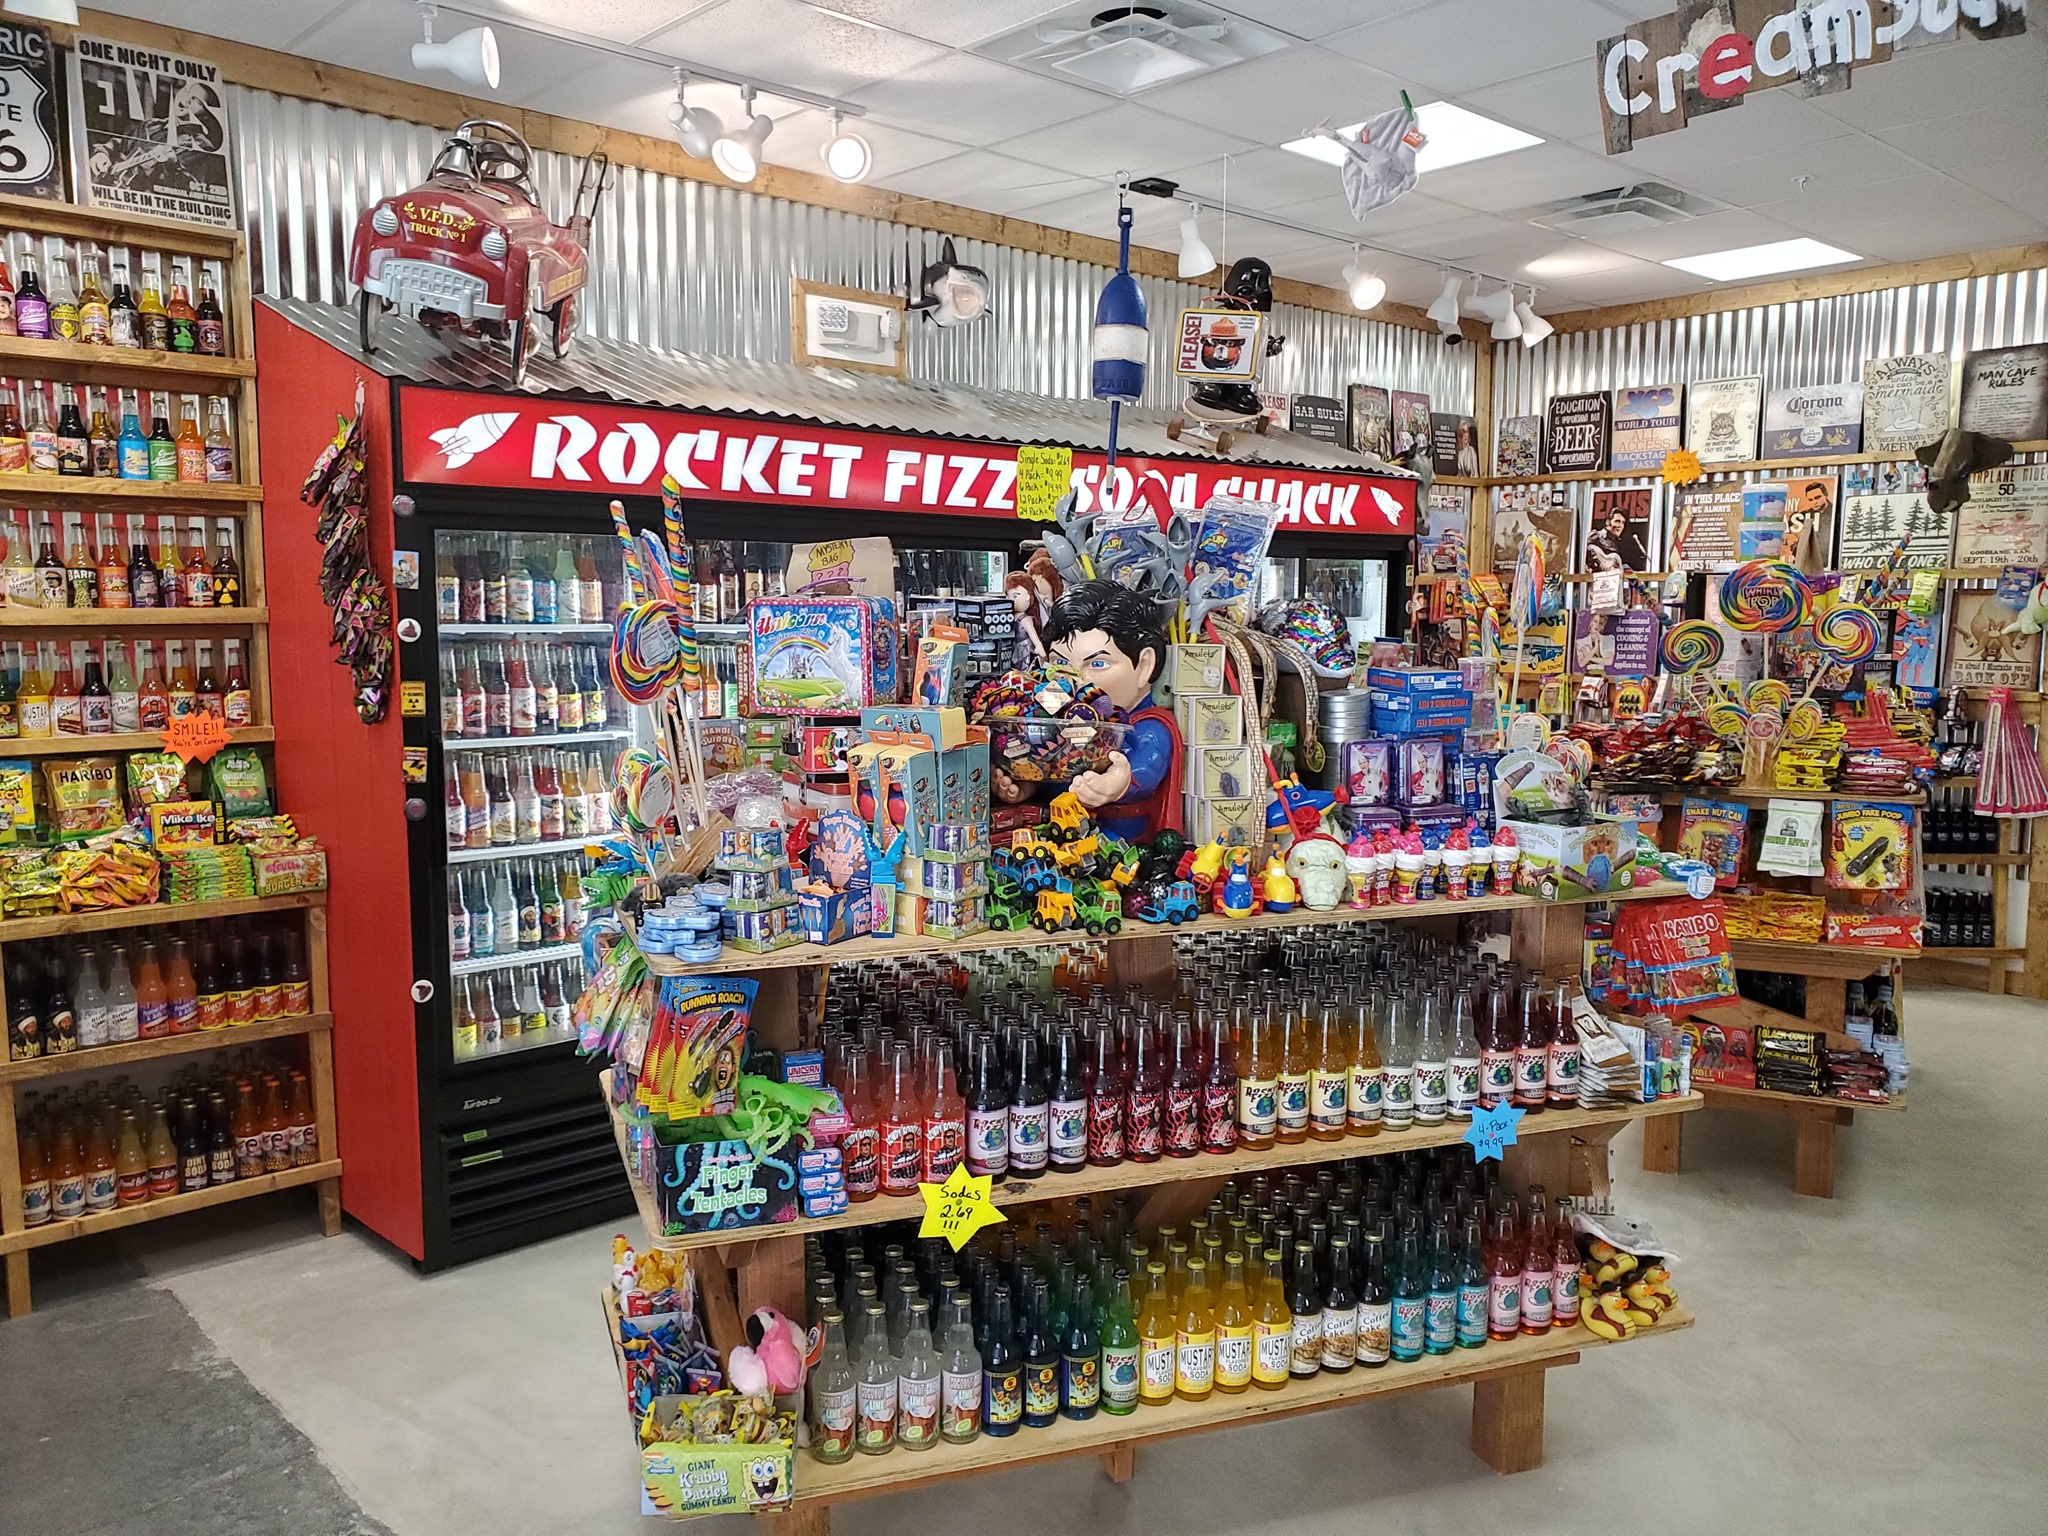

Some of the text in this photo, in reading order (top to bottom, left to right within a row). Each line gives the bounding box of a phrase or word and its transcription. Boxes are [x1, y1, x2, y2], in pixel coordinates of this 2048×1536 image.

[79, 39, 217, 82] ONE NIGHT ONLY
[91, 186, 122, 204] WILL
[123, 190, 139, 206] BE
[141, 193, 153, 208] IN
[155, 195, 177, 211] THE
[178, 199, 232, 220] BUILDING
[420, 207, 458, 227] V.F.D.
[410, 222, 444, 238] TRUCK
[1181, 316, 1203, 370] PLEASE!
[1876, 356, 1936, 380] ALWAYS
[1977, 366, 2038, 382] MAN CAVE
[1988, 377, 2025, 389] RULES
[1876, 381, 1936, 399] mermaid
[1556, 398, 1600, 415] EDUCATION
[1786, 395, 1844, 415] Corona
[1295, 405, 1345, 422] BAR RULES
[1555, 412, 1600, 425] IS IMPORTANT BUT
[1804, 410, 1824, 418] Extra
[1618, 417, 1676, 430] WORLD TOUR
[1554, 425, 1596, 453] BEER
[1632, 430, 1658, 441] ALL
[1618, 439, 1671, 452] ACCESS
[1867, 440, 1928, 453] A MERMA
[1020, 450, 1039, 472] Single
[1559, 453, 1595, 465] IMPORTANTER
[1617, 451, 1666, 462] BACKSTAG
[531, 416, 864, 499] ROCKET
[884, 449, 1017, 510] FIZZ
[1070, 465, 1198, 513] SOA
[1632, 460, 1655, 469] PASS
[1019, 483, 1024, 491] 6
[1019, 493, 1026, 504] 12
[1685, 492, 1741, 504] IN THIS PLACE
[1019, 507, 1028, 515] 24
[1692, 505, 1731, 514] WE ALWAYS
[821, 553, 839, 566] BAG
[1842, 555, 1946, 570] WHO ONE?
[1963, 555, 2038, 564] SEPT. 19th 20th
[16, 586, 28, 594] Pie
[1744, 586, 1782, 597] WHIRLY
[755, 611, 828, 637] Unicorn
[1622, 616, 1650, 625] understand
[1616, 625, 1651, 634] the concept of
[1616, 634, 1641, 642] COOKING
[1616, 643, 1648, 651] CLEANING.
[1184, 650, 1216, 658] Amulets
[1614, 662, 1631, 670] applies
[1965, 662, 1980, 670] afraid
[2014, 664, 2024, 672] you
[1953, 671, 2031, 686] BACK OFF
[1201, 702, 1232, 710] Amulets
[173, 723, 220, 737] SMILE!!
[702, 728, 732, 736] HANDI
[172, 738, 191, 748] You're
[1209, 752, 1240, 762] Amulets
[60, 768, 113, 784] HARIBO
[222, 772, 257, 782] ORGANIC
[1217, 803, 1248, 812] Amulets
[160, 814, 216, 825] Mike Ike
[1685, 808, 1743, 822] SNAKE NUT CAN
[1836, 809, 1903, 821] JUMBO FAKE POOP
[265, 879, 303, 894] BURGER
[1663, 913, 1720, 939] HARIBO
[1830, 914, 1870, 926] mega
[680, 992, 745, 1014] RUNNING ROACH
[1761, 1029, 1786, 1041] BLACK
[788, 1065, 821, 1076] UNICORN
[463, 1095, 502, 1111] Turbo air
[1478, 1136, 1504, 1149] $9.99
[186, 1156, 206, 1168] DIRT
[213, 1150, 232, 1162] DIRT
[185, 1165, 207, 1177] SODA
[212, 1159, 234, 1171] SODA
[702, 1164, 756, 1188] Finger
[691, 1184, 768, 1213] Tentacles
[940, 1185, 982, 1201] Sodas
[939, 1204, 974, 1220] 2.69
[1327, 1316, 1354, 1331] Coffee
[1363, 1310, 1391, 1325] Coffee
[1323, 1326, 1345, 1338] Cake
[1359, 1322, 1382, 1334] Cake
[1295, 1333, 1317, 1345] Cake
[1228, 1363, 1247, 1373] SODA
[1190, 1370, 1209, 1380] SODA
[902, 1381, 925, 1396] COCONUT
[950, 1375, 975, 1390] COCONUT
[861, 1384, 884, 1397] COCONUT
[958, 1390, 974, 1401] LIME
[869, 1399, 885, 1411] LIME
[910, 1395, 925, 1407] LIME
[687, 1459, 717, 1472] GIANT
[679, 1468, 729, 1489] Krabby
[682, 1485, 729, 1502] Patties
[681, 1494, 737, 1512] GUMMY CANDY
